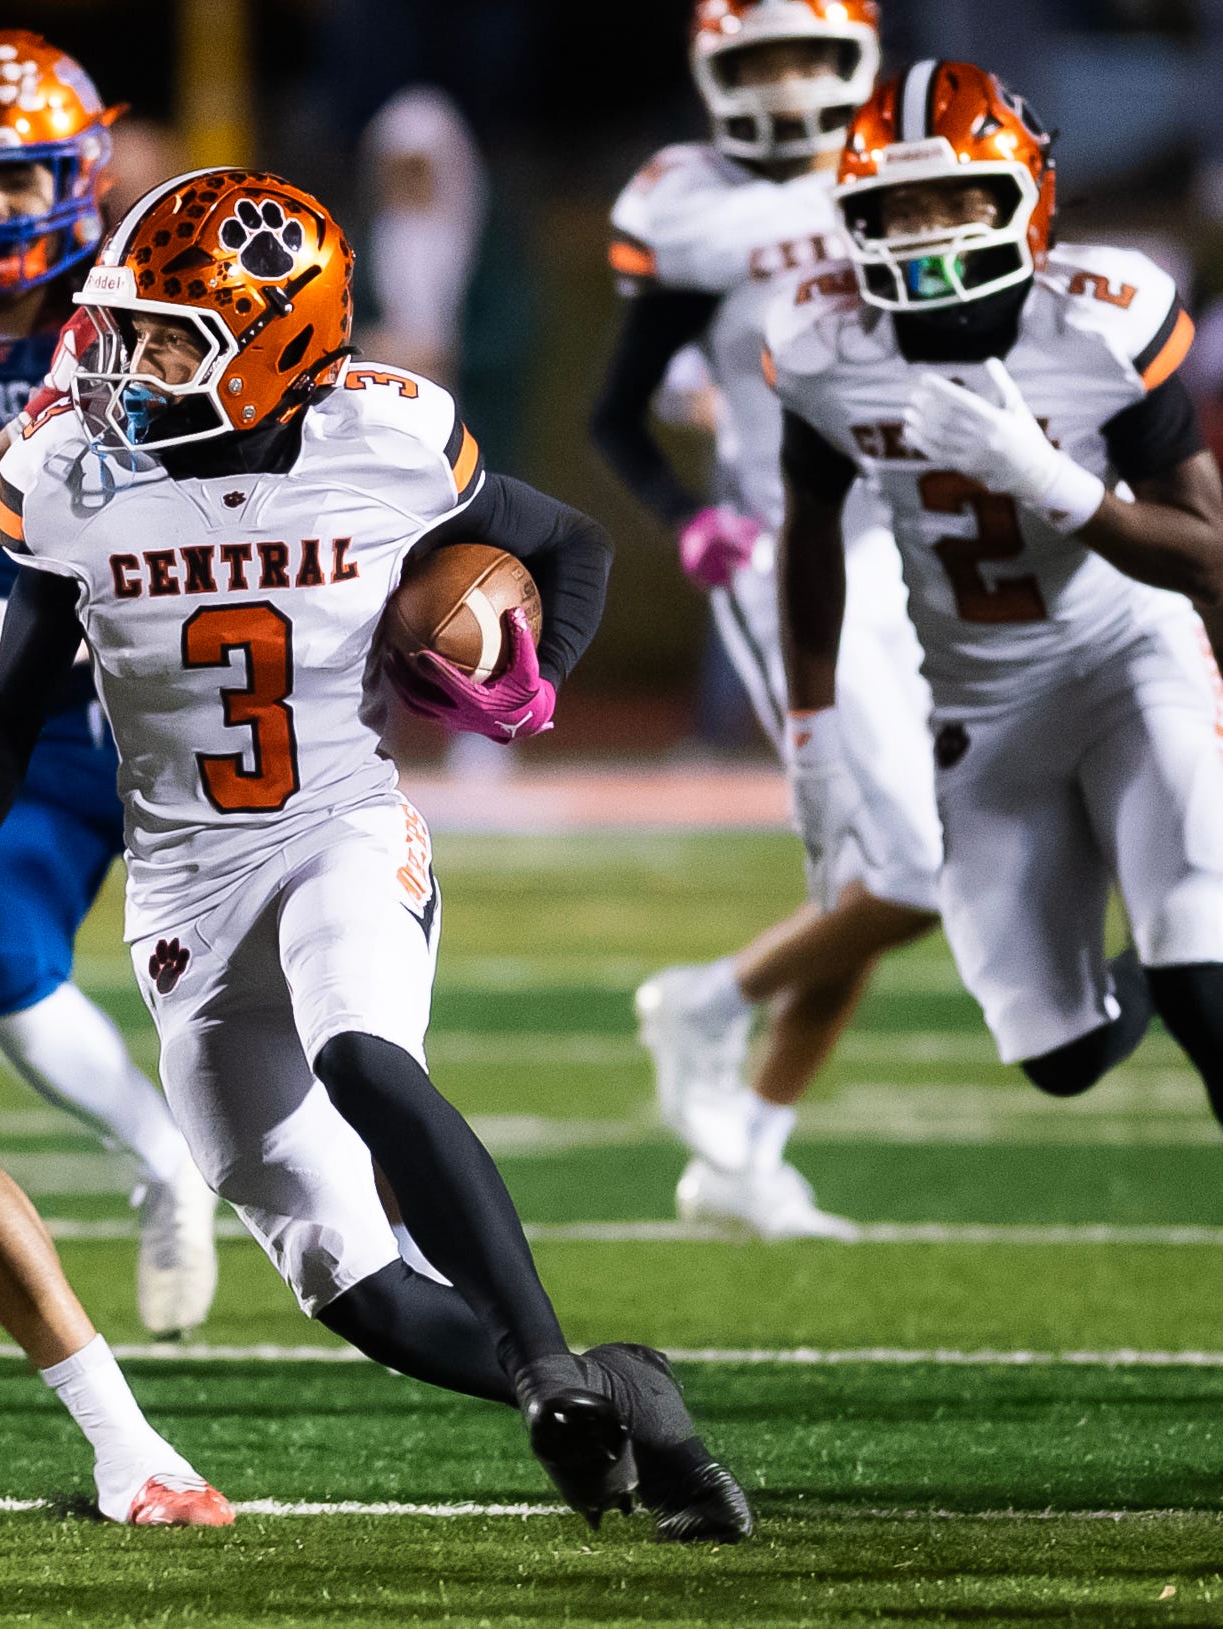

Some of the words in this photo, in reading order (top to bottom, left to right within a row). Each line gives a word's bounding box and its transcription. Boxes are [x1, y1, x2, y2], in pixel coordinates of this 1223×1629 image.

[1067, 271, 1137, 310] 2
[344, 369, 419, 399] 3
[109, 537, 360, 599] CENTRAL
[917, 469, 1048, 624] 2
[180, 600, 301, 815] 3
